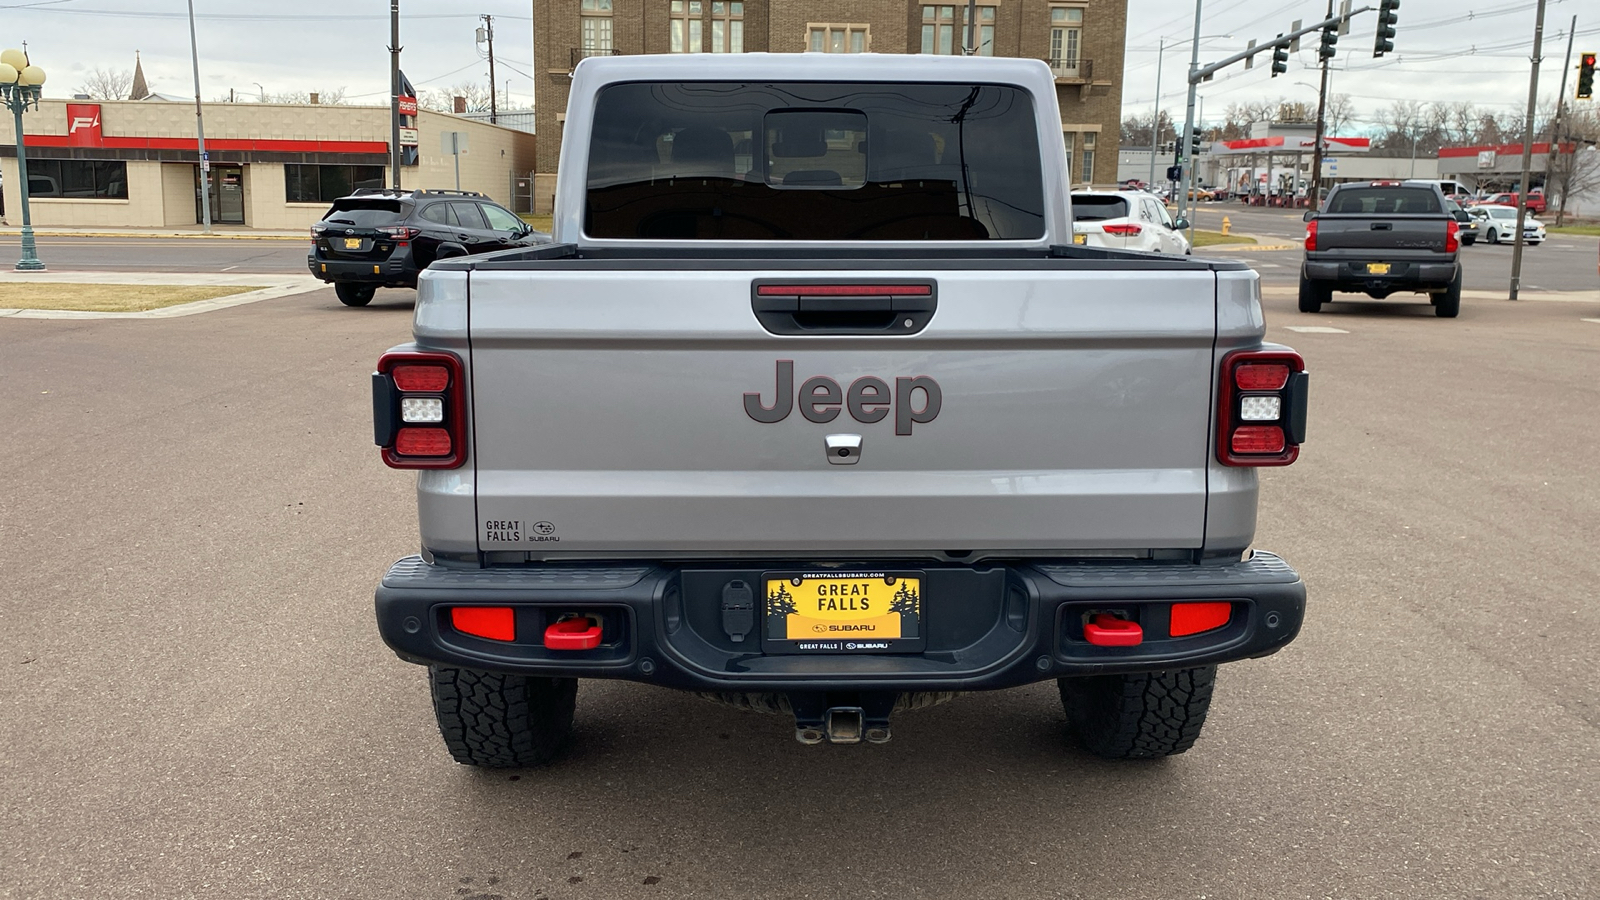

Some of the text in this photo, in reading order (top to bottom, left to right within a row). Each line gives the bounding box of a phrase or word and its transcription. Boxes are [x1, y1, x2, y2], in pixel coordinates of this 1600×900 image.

[743, 359, 942, 436] Jeep
[486, 521, 519, 530] GREAT
[487, 531, 520, 541] FALLS
[817, 584, 870, 596] GREAT
[818, 598, 870, 611] FALLS
